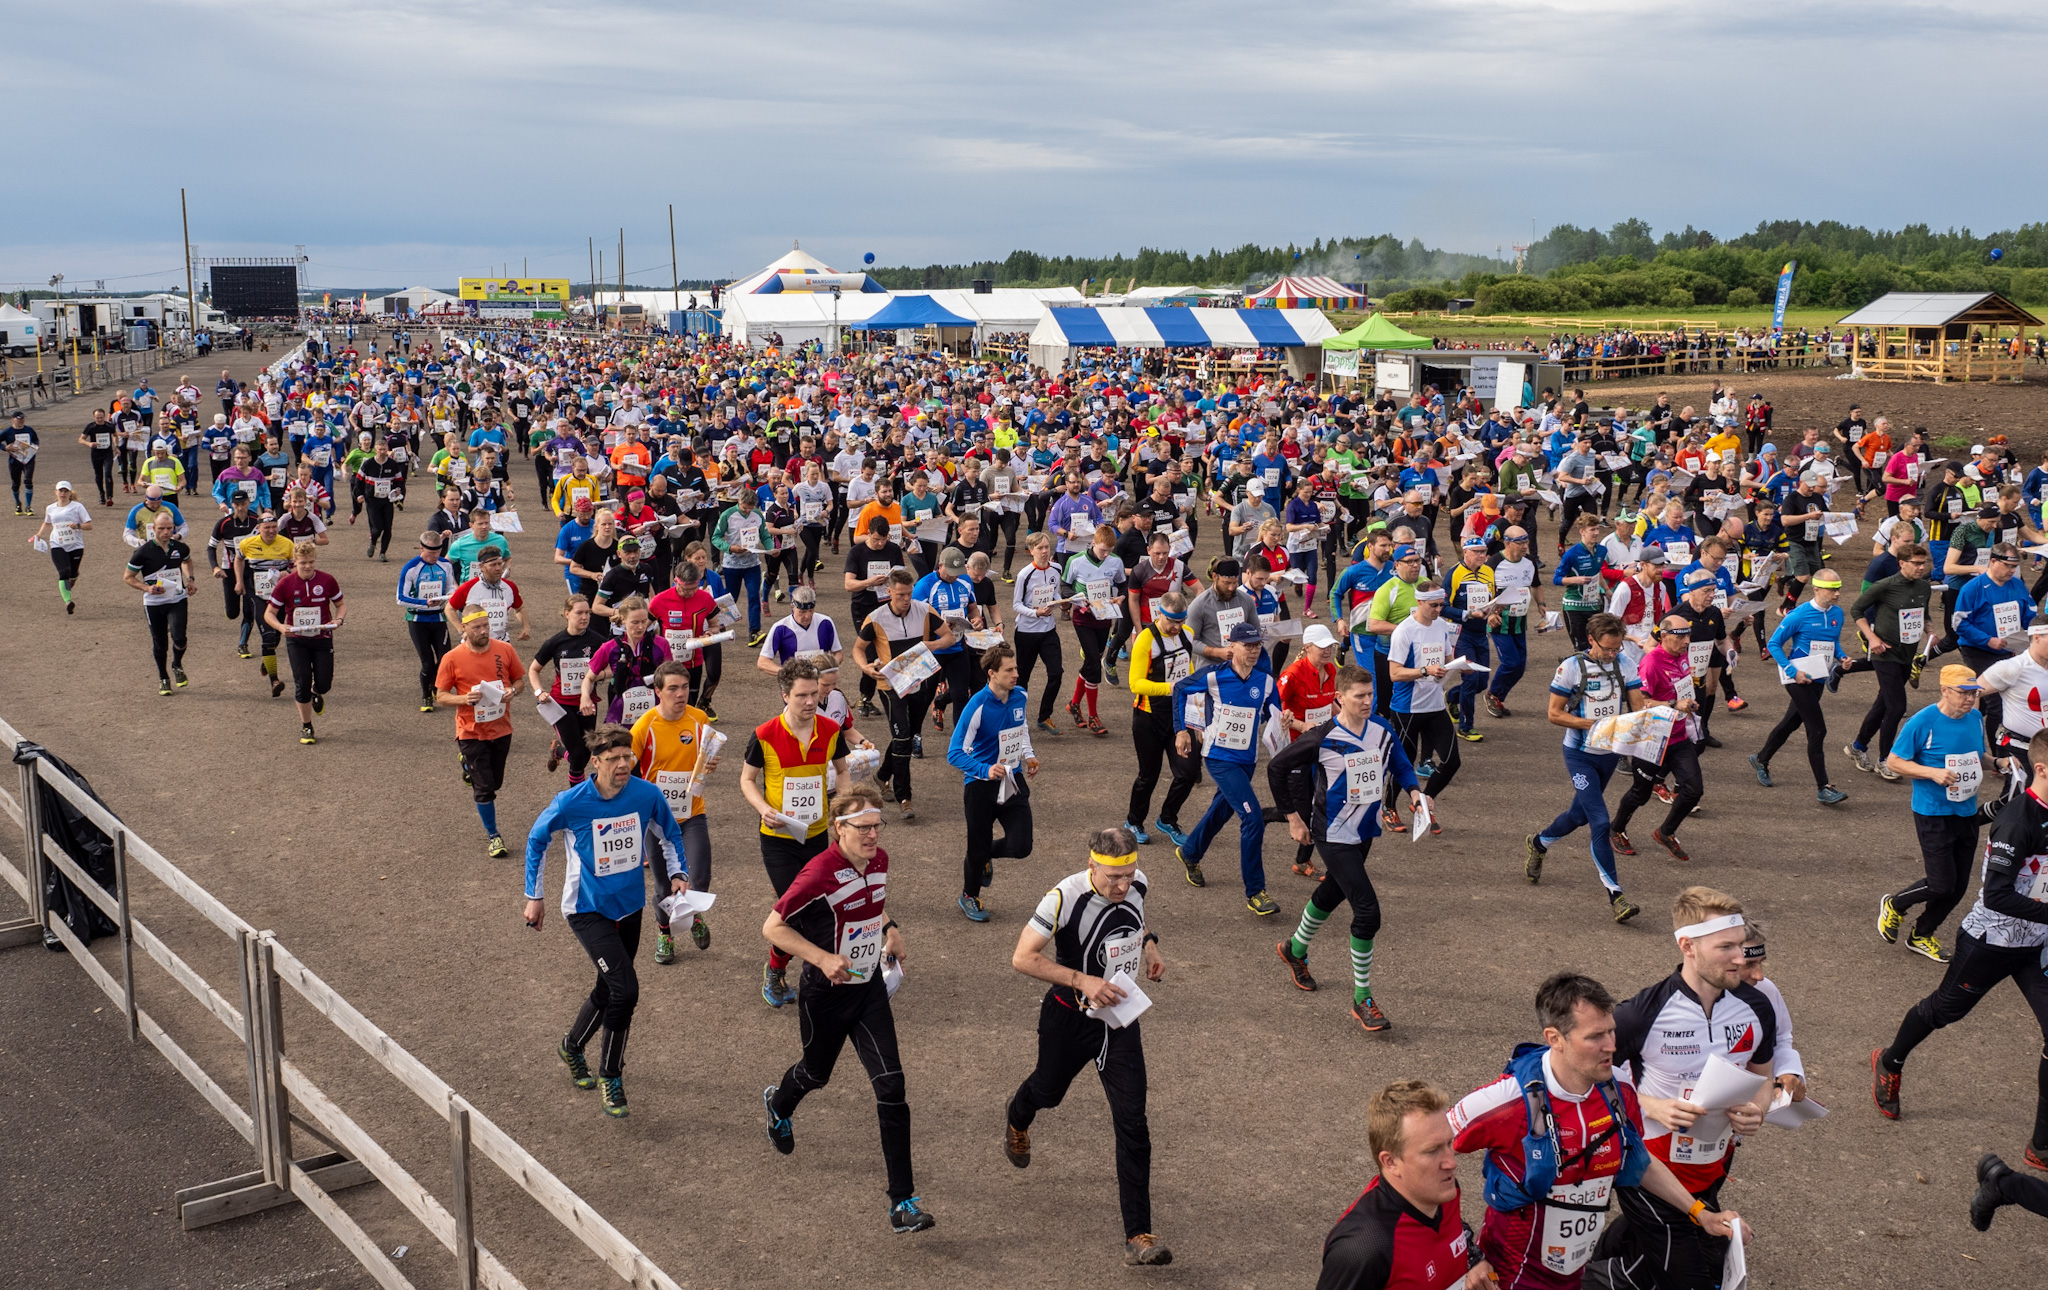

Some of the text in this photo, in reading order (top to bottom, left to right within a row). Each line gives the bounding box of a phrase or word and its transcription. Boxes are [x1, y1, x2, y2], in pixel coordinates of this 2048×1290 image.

[1831, 345, 1840, 355] WC
[1903, 621, 1922, 630] 1256
[1999, 616, 2018, 625] 1256
[1693, 655, 1709, 664] 933
[567, 672, 585, 681] 576
[632, 688, 647, 697] Sata
[629, 701, 650, 712] 846
[1594, 705, 1615, 716] 983
[1231, 711, 1246, 719] Sata
[1225, 721, 1246, 733] 799
[1005, 742, 1020, 755] 822
[1357, 757, 1373, 767] Sata
[1355, 770, 1377, 785] 766
[796, 782, 814, 791] Sata
[792, 796, 816, 808] 520
[613, 818, 636, 828] INTER
[613, 825, 636, 835] SPORT
[603, 837, 634, 853] 1198
[631, 855, 637, 863] 5
[862, 922, 881, 933] INTER
[862, 930, 880, 941] SPORT
[850, 943, 875, 959] 870
[1121, 942, 1137, 956] Sata
[1660, 1043, 1701, 1051] Auranmaan
[1719, 1139, 1726, 1151] 6
[1569, 1190, 1596, 1205] Sata
[1560, 1213, 1598, 1239] 508
